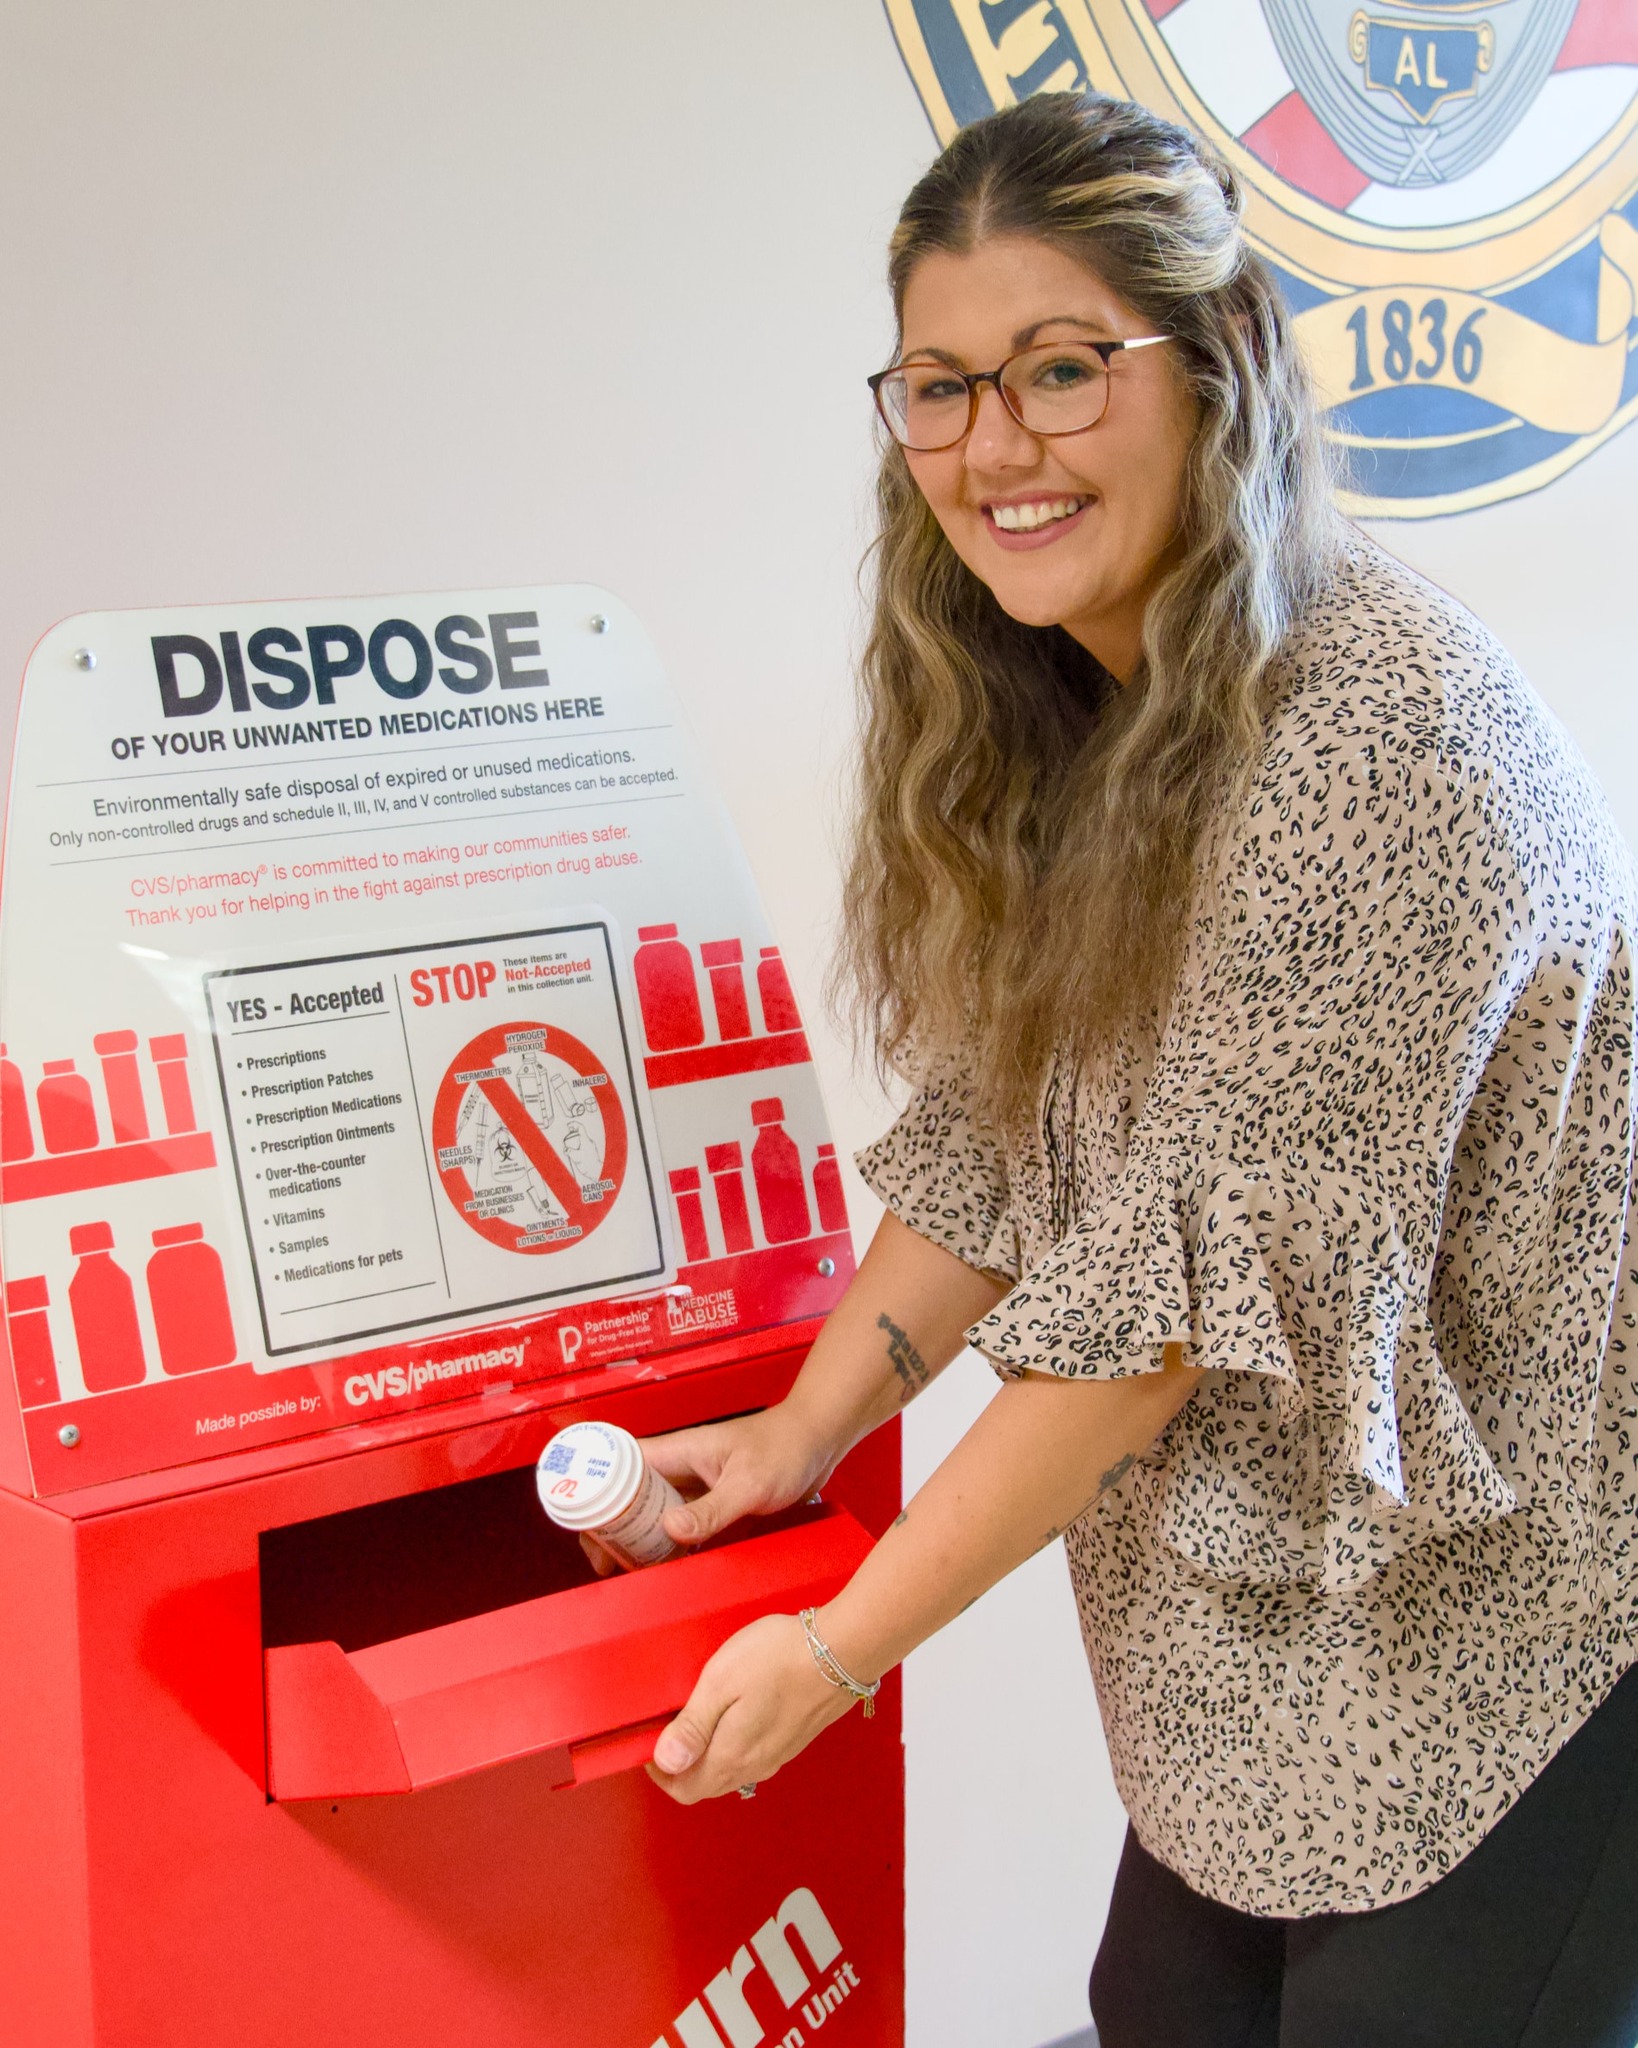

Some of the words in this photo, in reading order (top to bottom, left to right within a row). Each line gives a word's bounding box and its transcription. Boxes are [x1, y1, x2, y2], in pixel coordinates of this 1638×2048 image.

[1395, 36, 1448, 89] AL
[1345, 297, 1488, 391] 1836
[151, 611, 550, 718] DISPOSE
[111, 736, 145, 760] OF
[152, 730, 227, 756] YOUR
[233, 717, 373, 749] UNWANTED
[379, 702, 538, 736] MEDICATIONS
[543, 697, 605, 721] HERE
[93, 787, 239, 817] Environmentally
[245, 782, 282, 801] safe
[287, 774, 359, 799] disposal
[364, 772, 382, 790] of
[386, 766, 448, 788] expired
[452, 768, 469, 780] or
[473, 757, 533, 779] unused
[537, 749, 636, 772] medications.
[49, 831, 84, 848] Only
[88, 819, 194, 843] non-controlled
[199, 814, 239, 832] drugs
[243, 810, 269, 827] and
[273, 804, 334, 823] schedule
[338, 802, 351, 817] II,
[354, 801, 371, 815] III,
[373, 799, 390, 813] IV,
[393, 795, 417, 811] and
[421, 794, 430, 808] V
[433, 787, 497, 807] controlled
[500, 781, 572, 799] substances
[575, 778, 597, 791] can
[600, 774, 616, 788] be
[619, 767, 678, 786] accepted.
[273, 864, 288, 880] is
[292, 849, 378, 879] committed
[382, 852, 399, 867] to
[403, 845, 460, 863] making
[464, 843, 489, 858] our
[493, 830, 589, 855] communities
[592, 825, 630, 842] safer.
[125, 904, 182, 927] Thank
[186, 902, 217, 924] you
[220, 897, 245, 915] for
[249, 891, 310, 912] helping
[314, 887, 330, 904] in
[333, 883, 359, 900] the
[363, 877, 399, 901] fight
[403, 871, 460, 896] against
[464, 860, 553, 889] prescription
[556, 856, 591, 874] drug
[594, 850, 642, 868] abuse.
[502, 958, 528, 967] These
[530, 954, 553, 963] items
[555, 952, 567, 960] are
[505, 958, 592, 982] Not-Accepted
[410, 960, 496, 1007] STOP
[508, 985, 516, 993] in
[518, 982, 534, 992] this
[536, 977, 575, 990] collection
[227, 998, 267, 1023] YES
[290, 982, 385, 1015] Accepted
[506, 1030, 546, 1043] HYDROGEN
[508, 1042, 544, 1053] PEROXIDE
[247, 1049, 326, 1070] Prescriptions
[252, 1077, 324, 1098] Prescription
[327, 1070, 373, 1086] Patches
[456, 1067, 512, 1082] THERMOMETERS
[572, 1075, 607, 1087] INHALERS
[256, 1105, 329, 1126] Prescription
[332, 1093, 402, 1114] Medications
[261, 1132, 333, 1154] Prescription
[336, 1121, 395, 1142] Ointments
[440, 1145, 472, 1158] NEEDLES
[265, 1154, 366, 1181] Over-the-counter
[269, 1176, 342, 1199] medications
[474, 1185, 513, 1198] MEDICATION
[582, 1180, 614, 1193] AEROSOL
[583, 1191, 603, 1202] CANS
[465, 1200, 484, 1210] FROM
[486, 1193, 525, 1207] BUSINESSES
[479, 1209, 489, 1218] OR
[490, 1205, 515, 1216] CLINICS
[272, 1207, 325, 1227] Vitamins
[279, 1235, 329, 1254] Samples
[517, 1233, 546, 1246] LOTIONS
[555, 1227, 581, 1239] LIQUIDS
[284, 1259, 355, 1282] Medications
[358, 1255, 374, 1268] for
[378, 1249, 403, 1266] pets
[681, 1289, 734, 1310] MEDICINE
[685, 1301, 737, 1327] ABUSE
[704, 1316, 738, 1331] PROJECT
[196, 1413, 236, 1435] Made
[239, 1399, 297, 1429] possible
[301, 1395, 321, 1413] by:
[586, 1467, 607, 1478] Refill
[801, 1961, 860, 2030] Unit
